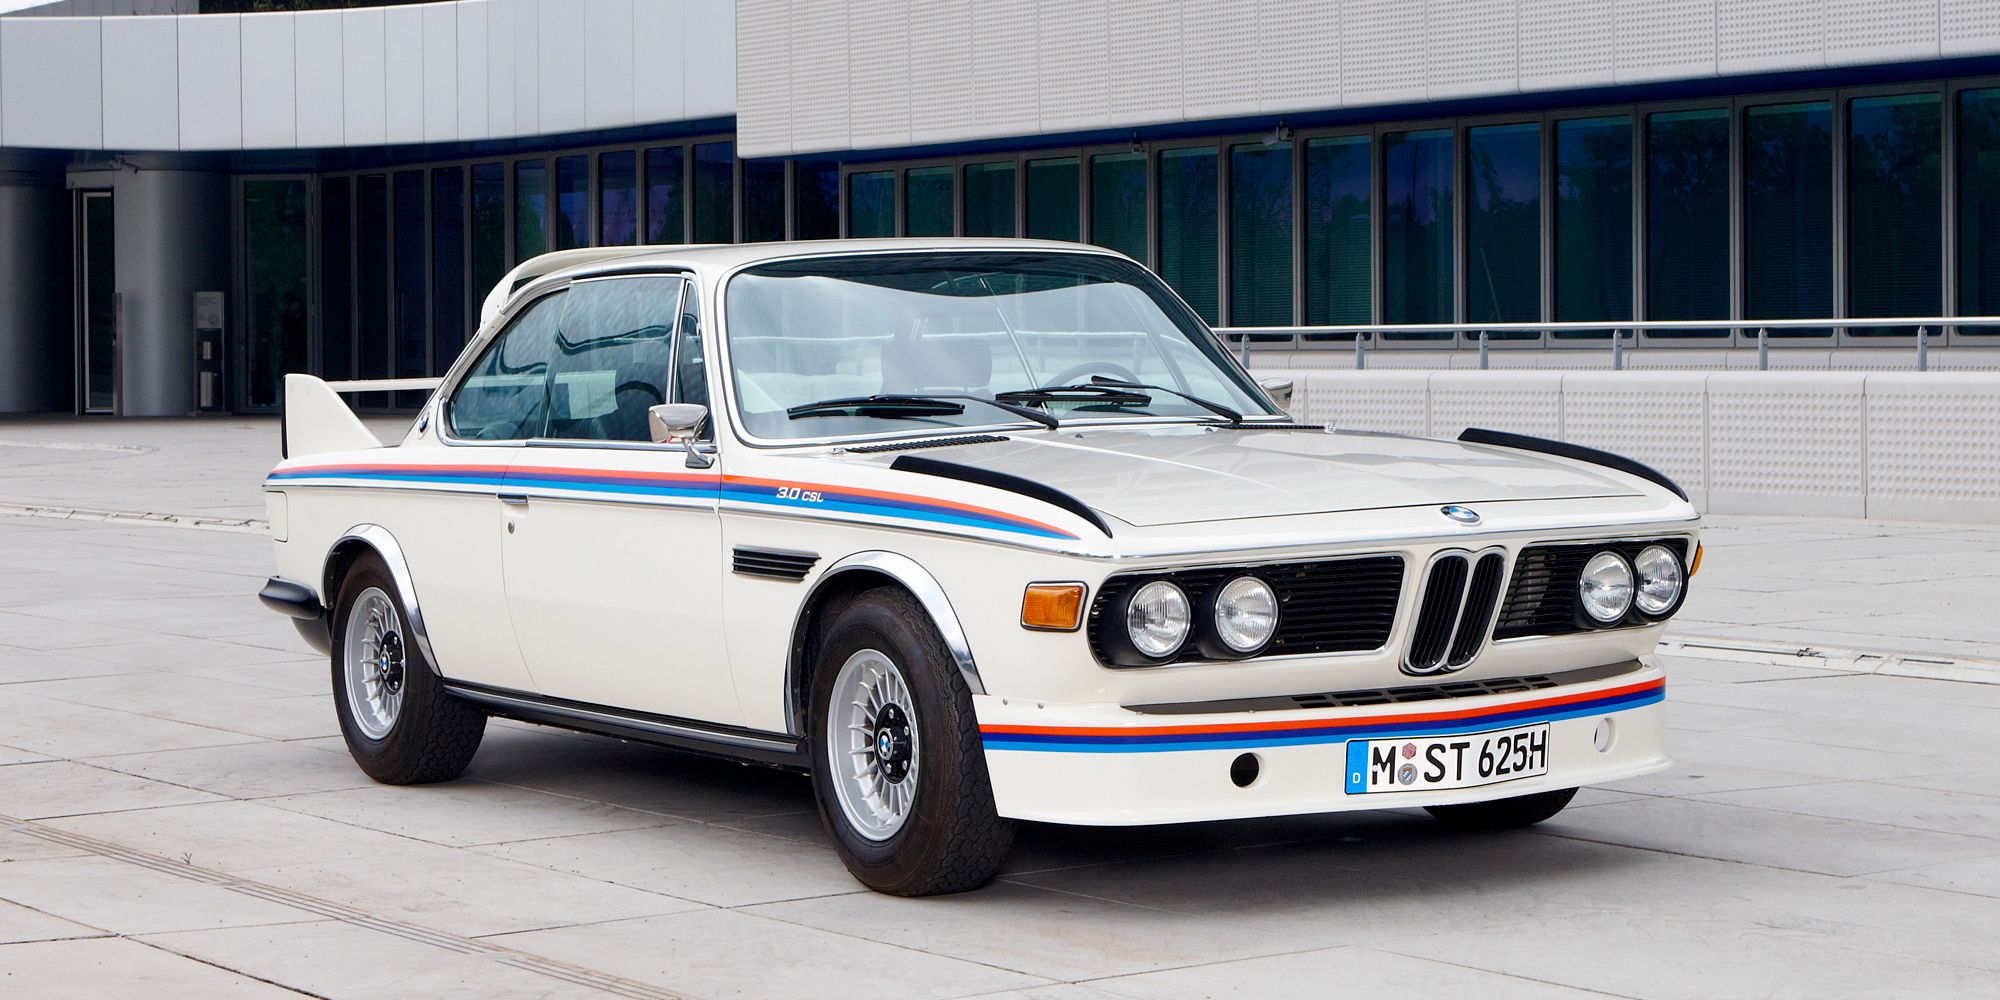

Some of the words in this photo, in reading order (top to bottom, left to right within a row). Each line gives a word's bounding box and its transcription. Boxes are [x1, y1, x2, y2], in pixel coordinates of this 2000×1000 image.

[776, 487, 801, 499] 3.0
[801, 491, 824, 502] CSL
[1371, 745, 1397, 785] M
[1423, 742, 1471, 783] ST
[1478, 729, 1547, 778] 625H
[1352, 773, 1361, 784] D
